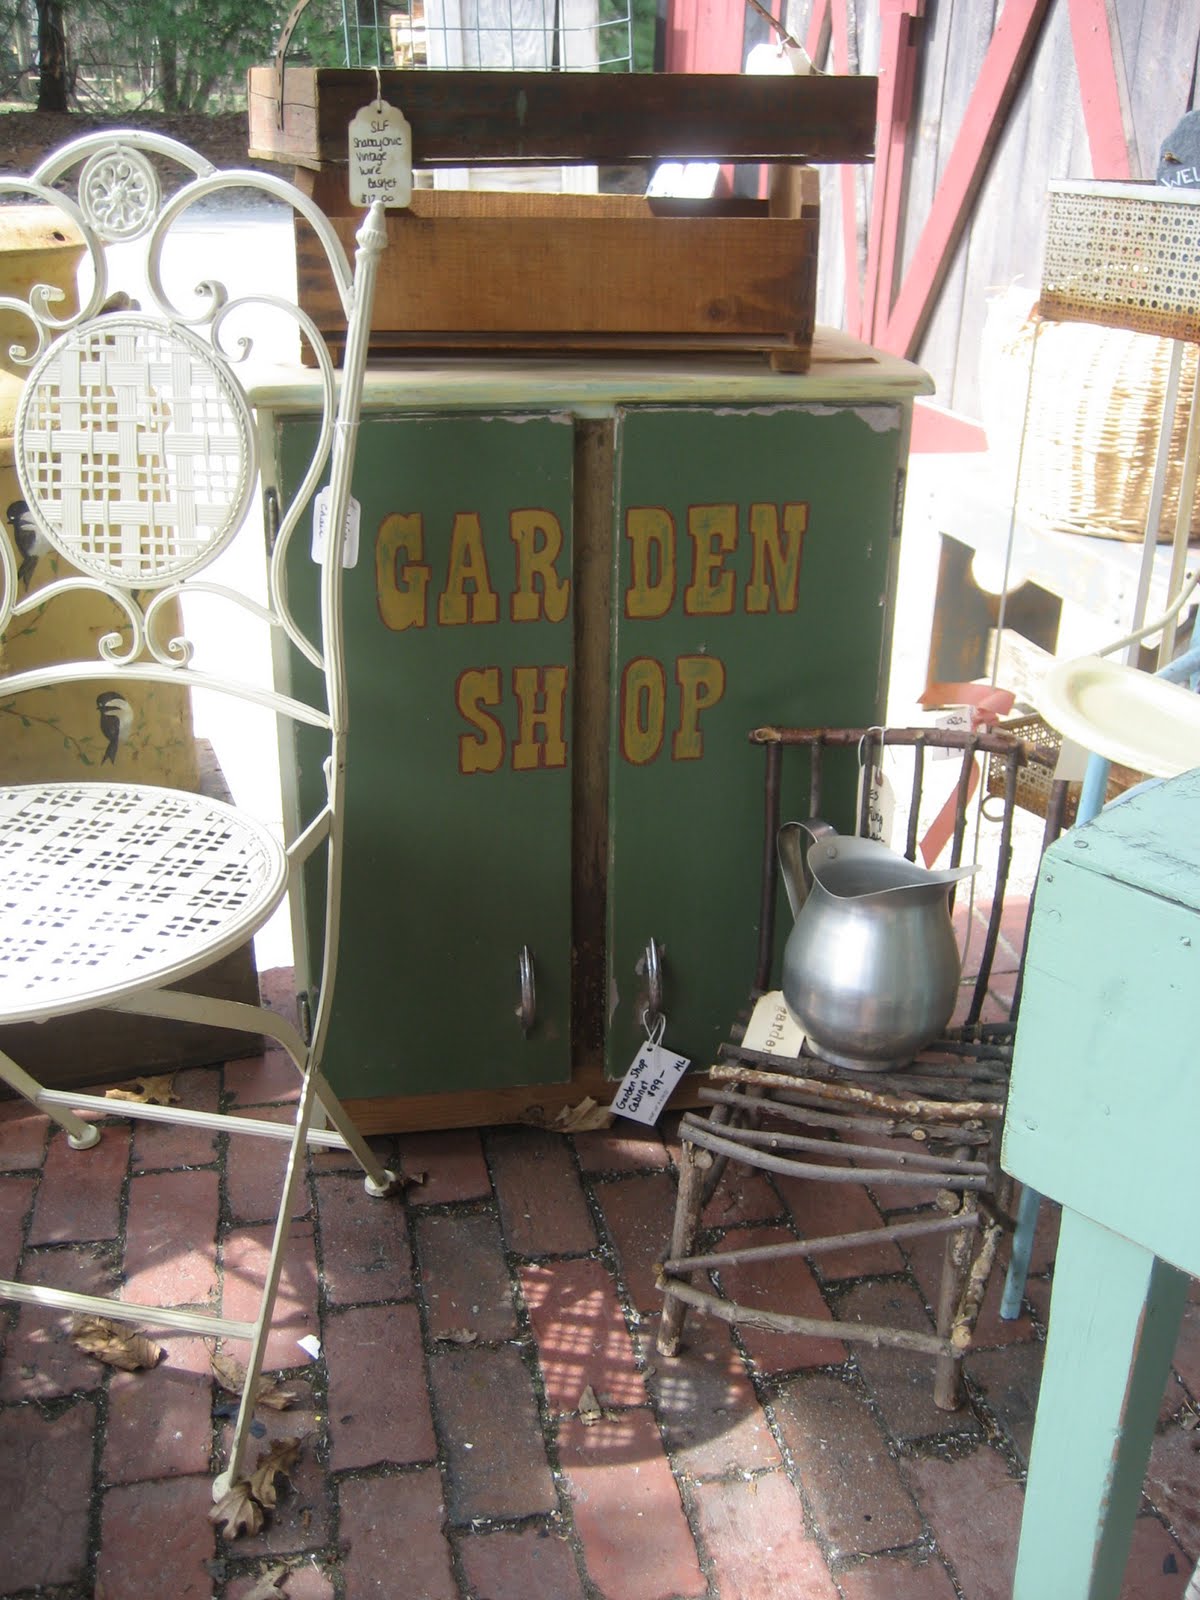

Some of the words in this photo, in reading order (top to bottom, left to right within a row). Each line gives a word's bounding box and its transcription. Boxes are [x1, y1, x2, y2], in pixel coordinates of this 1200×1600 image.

[615, 1080, 637, 1110] Garden
[630, 1059, 648, 1079] Shop
[628, 1080, 649, 1113] Cabinet
